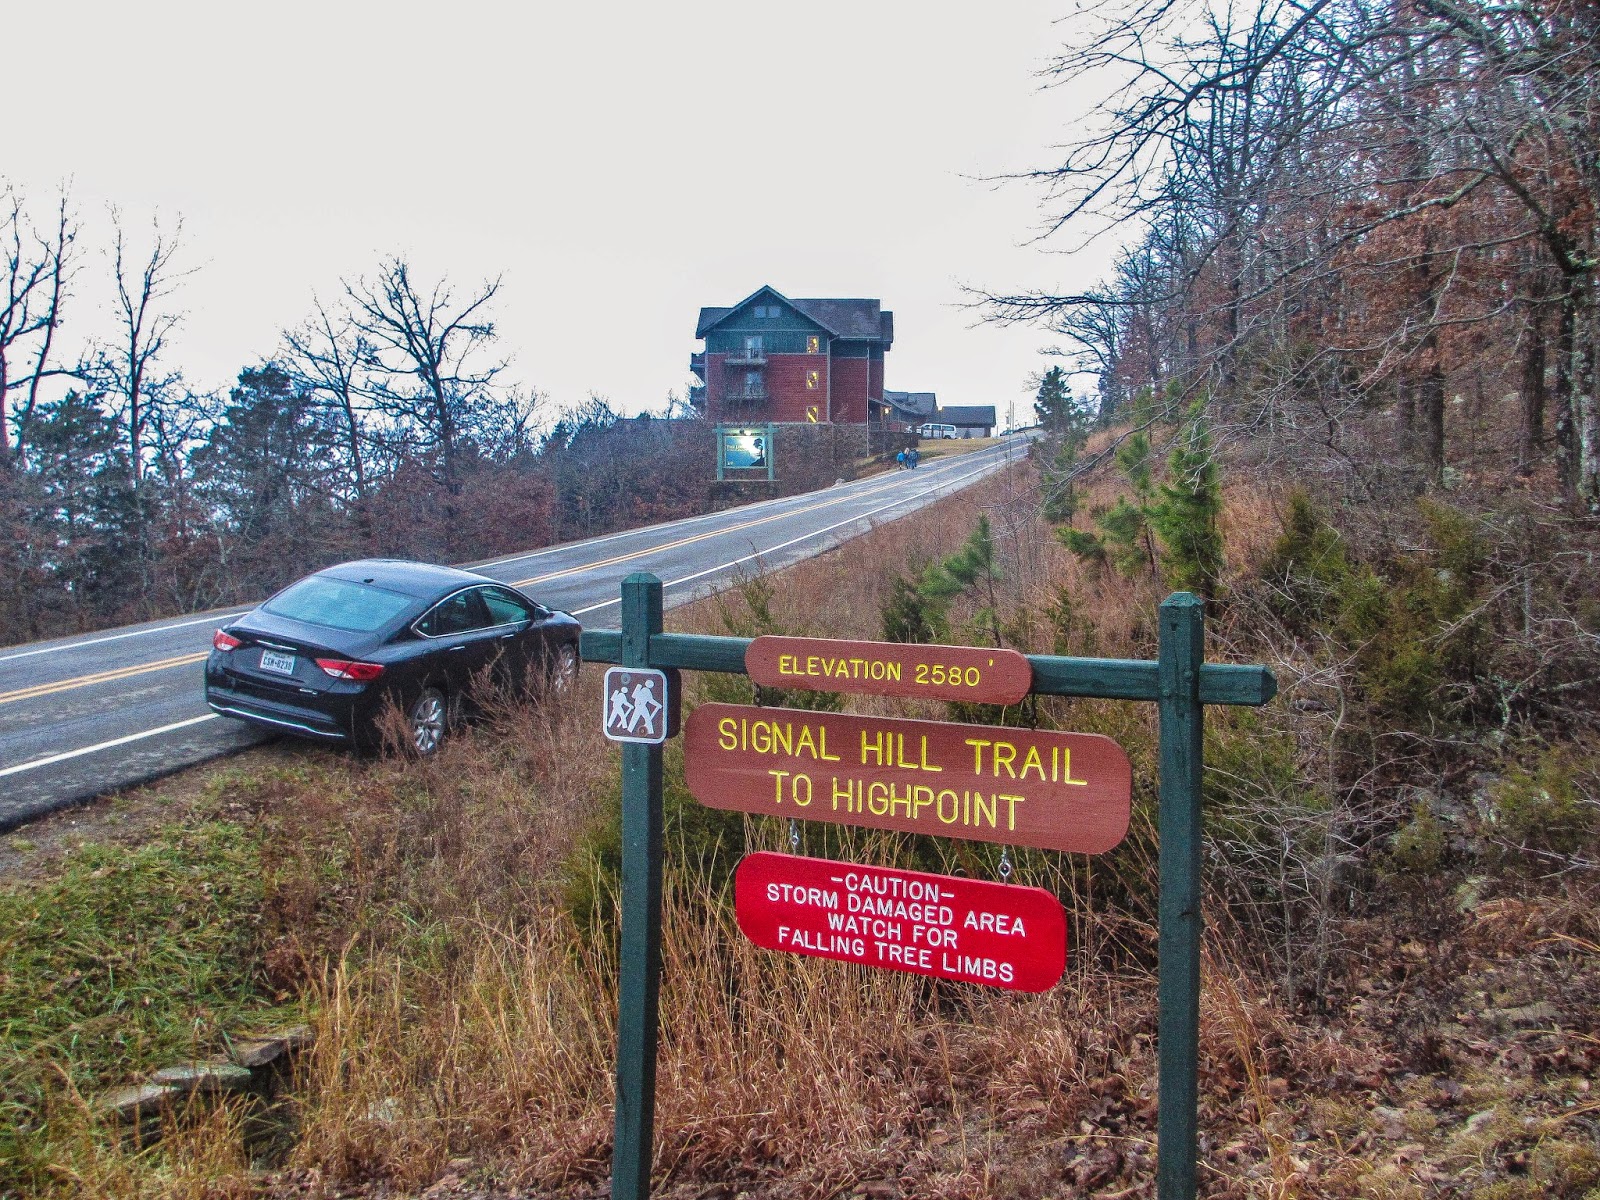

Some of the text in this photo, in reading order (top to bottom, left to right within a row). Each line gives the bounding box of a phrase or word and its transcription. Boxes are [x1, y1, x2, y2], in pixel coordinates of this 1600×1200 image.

[779, 656, 902, 681] ELEVATION
[718, 717, 1088, 786] SIGNAL HILL TRAIL
[768, 770, 1026, 831] TO HIGHPOINT
[767, 883, 1026, 937] STORM DAMAGED AREA
[827, 913, 958, 948] WATCH FOR
[778, 927, 1014, 983] FALLING TREE LIMBS
